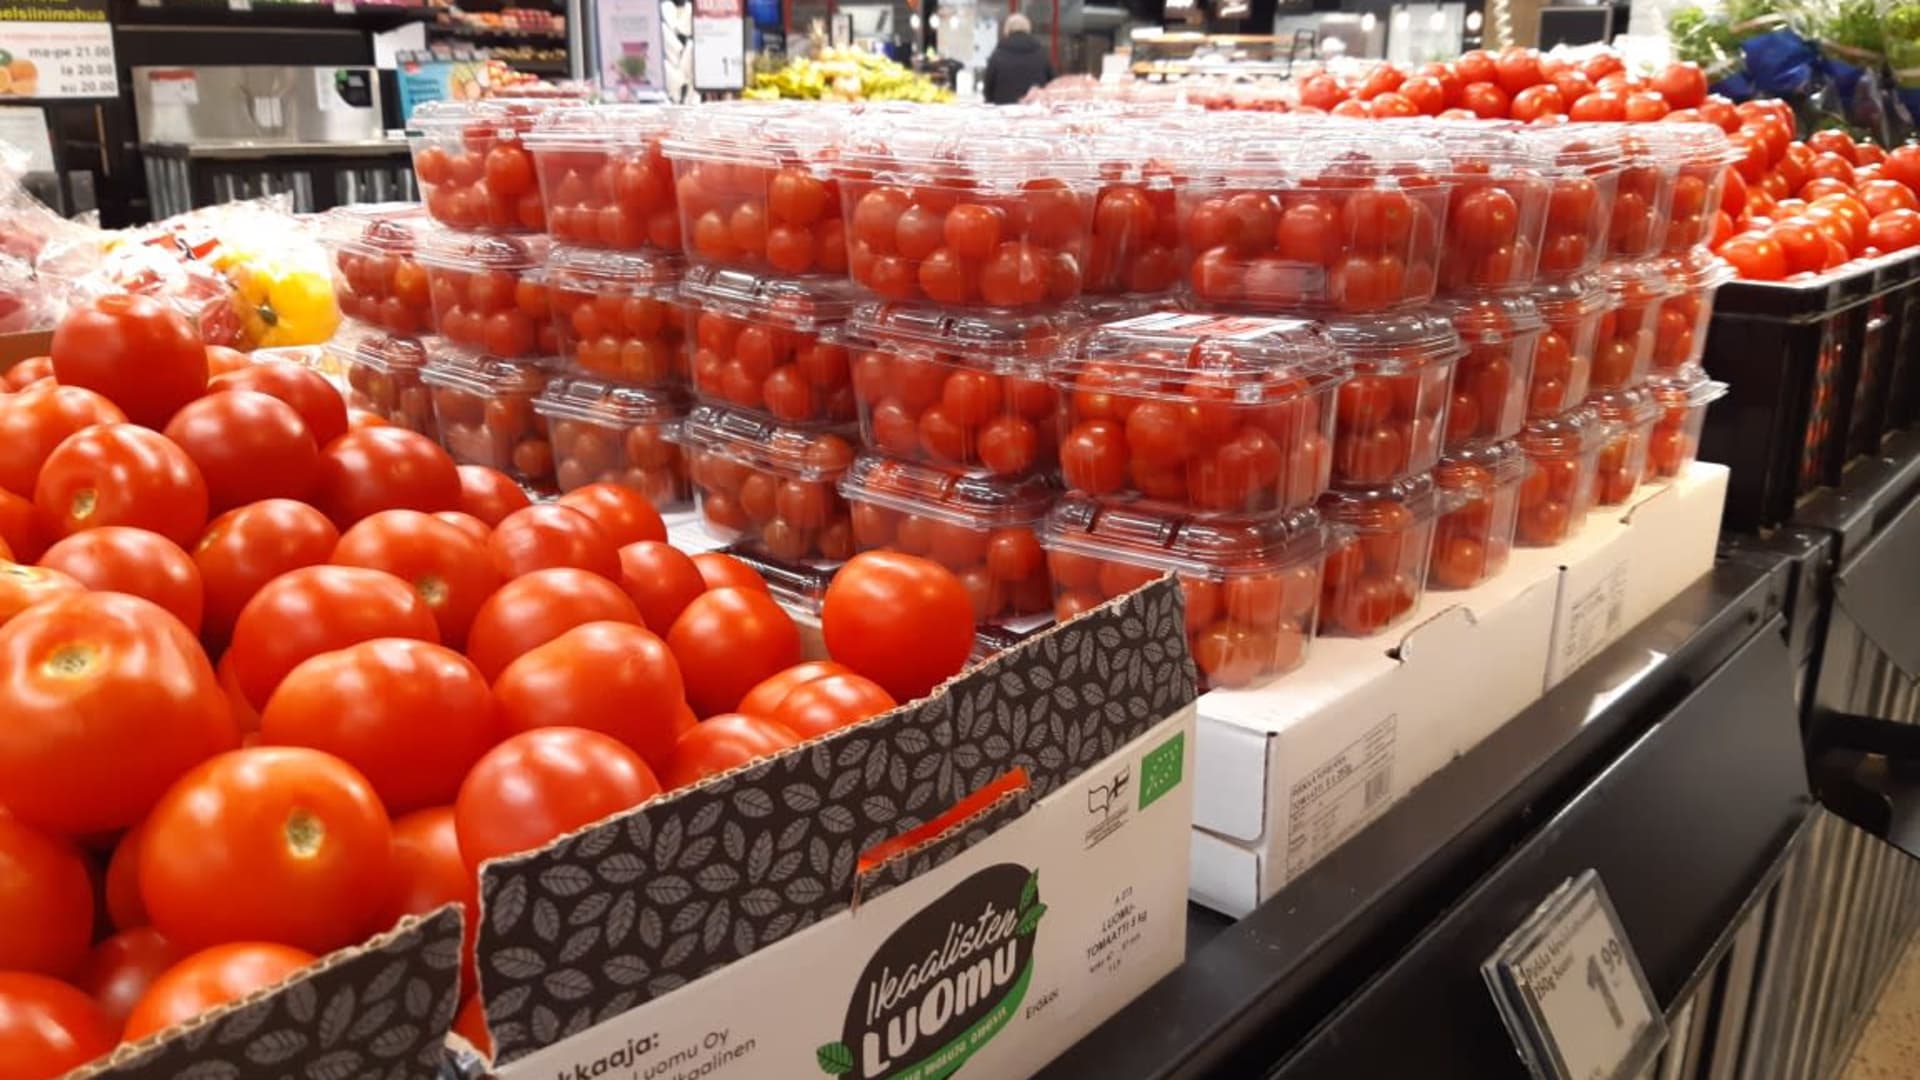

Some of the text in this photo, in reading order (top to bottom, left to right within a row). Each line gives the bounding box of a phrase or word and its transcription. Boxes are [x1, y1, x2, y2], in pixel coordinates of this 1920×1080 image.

[1086, 920, 1130, 960] TOMAATTI
[866, 901, 1018, 1026] Ikaalisten
[703, 1028, 730, 1050] Oy
